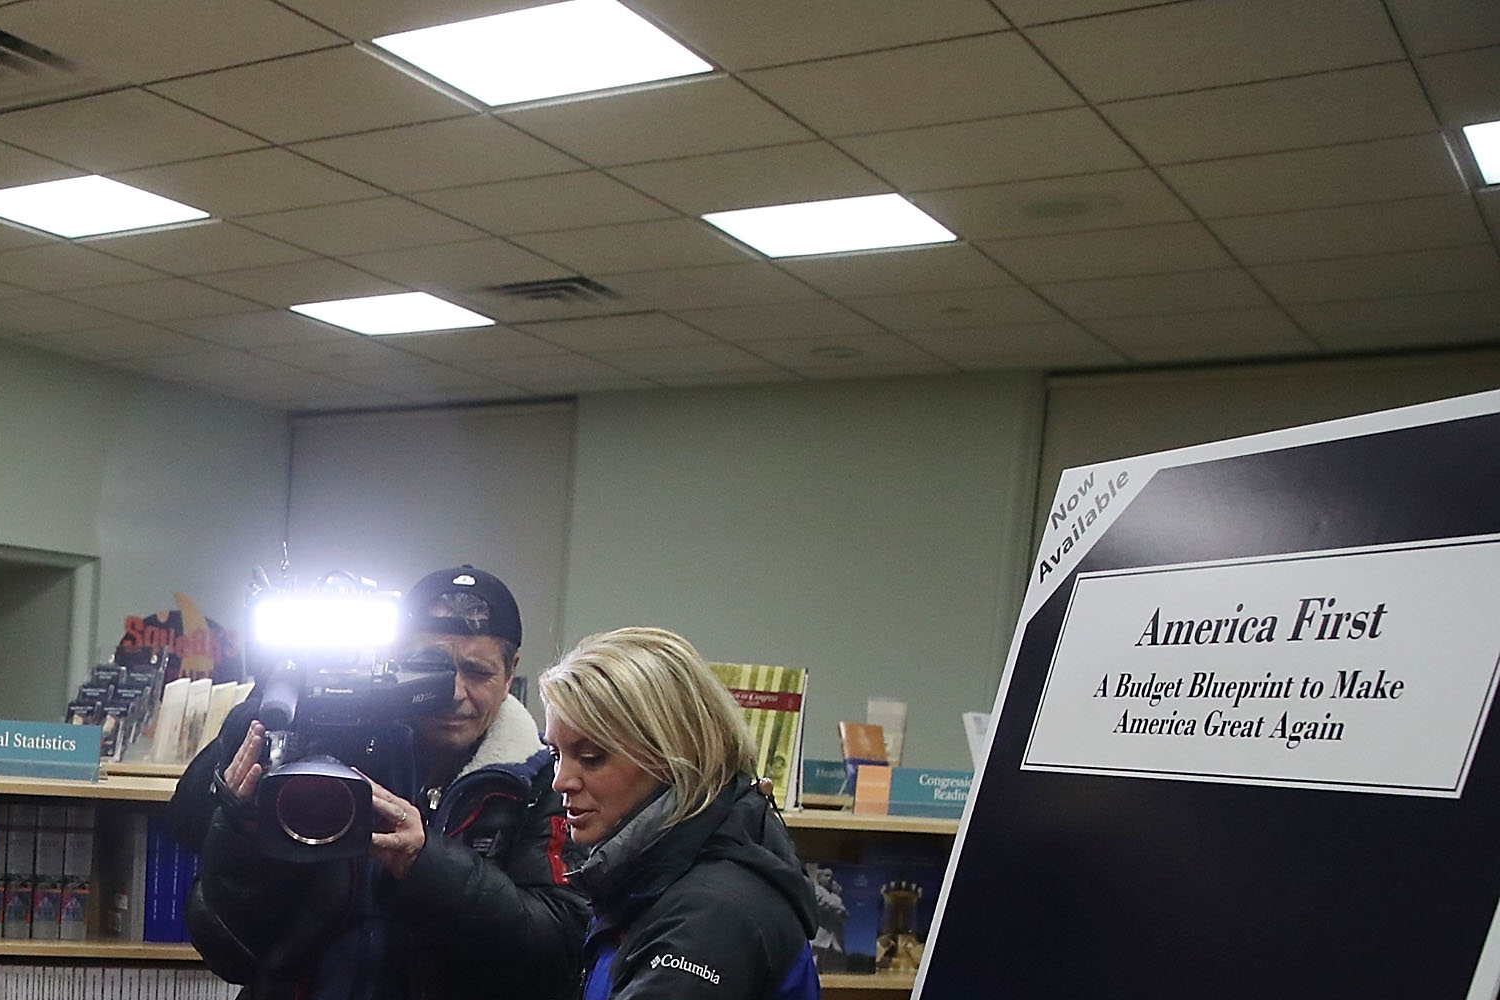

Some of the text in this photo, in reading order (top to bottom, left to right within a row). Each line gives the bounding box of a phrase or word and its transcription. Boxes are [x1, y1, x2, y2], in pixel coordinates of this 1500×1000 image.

[1051, 471, 1095, 531] Now
[1039, 471, 1129, 584] Available
[1135, 597, 1389, 647] America First
[1093, 669, 1405, 708] A Budget Blueprint to Make
[14, 733, 77, 751] Statistics
[1112, 709, 1346, 749] America Great Again
[660, 953, 721, 984] Columbia
